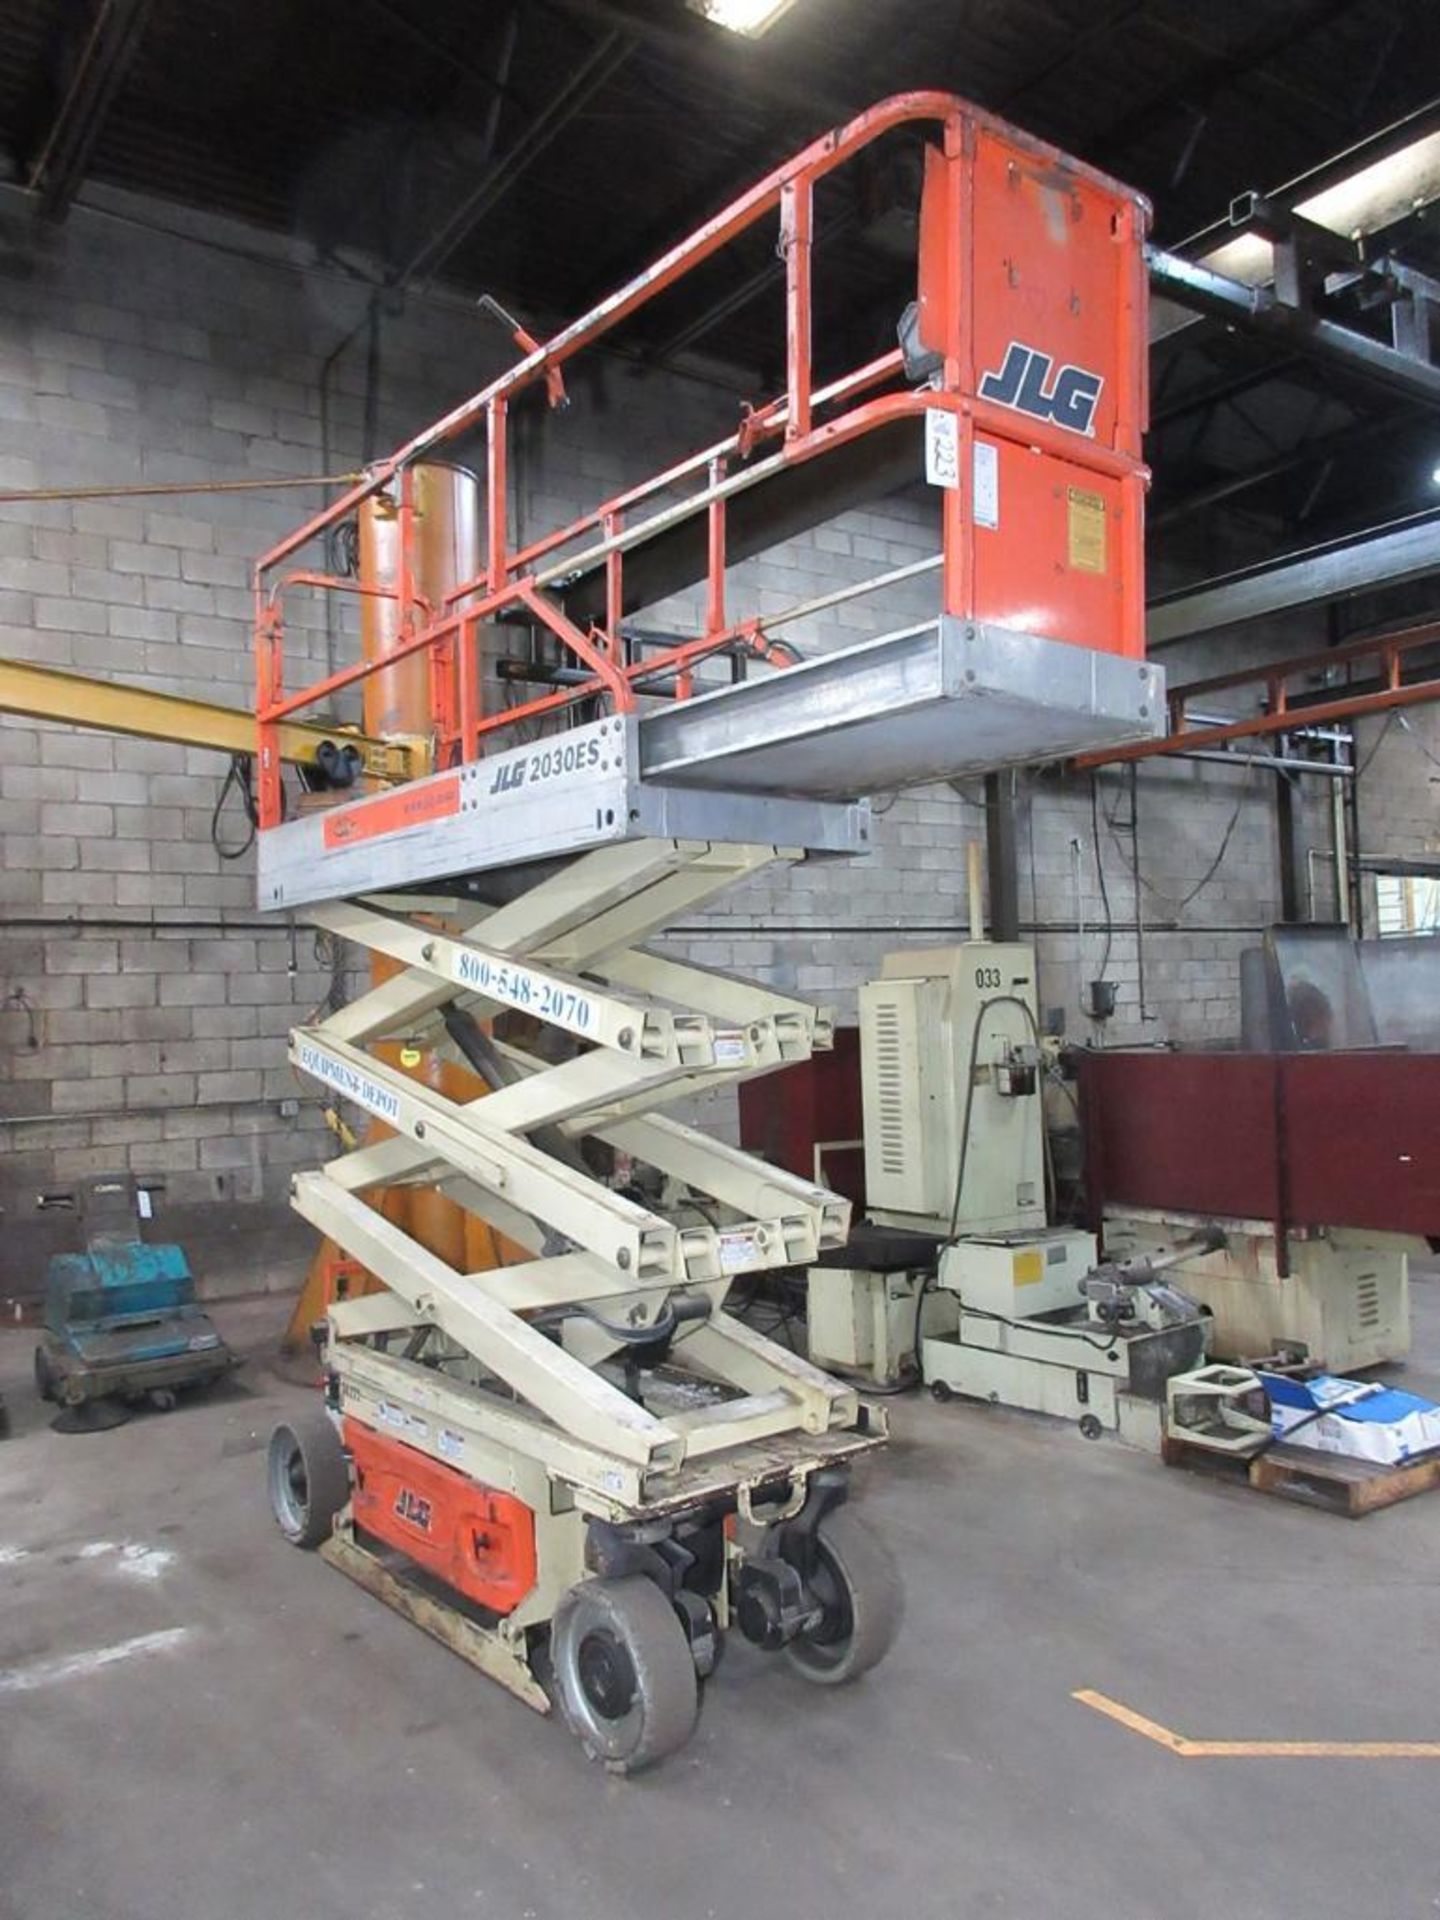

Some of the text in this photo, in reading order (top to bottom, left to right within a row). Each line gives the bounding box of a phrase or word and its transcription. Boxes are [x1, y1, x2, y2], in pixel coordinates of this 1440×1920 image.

[978, 341, 1103, 437] JLG
[490, 739, 600, 795] JLG 2030ES
[459, 953, 590, 1029] 800-548-2070
[975, 967, 1001, 988] 033
[394, 1488, 432, 1531] JLG
